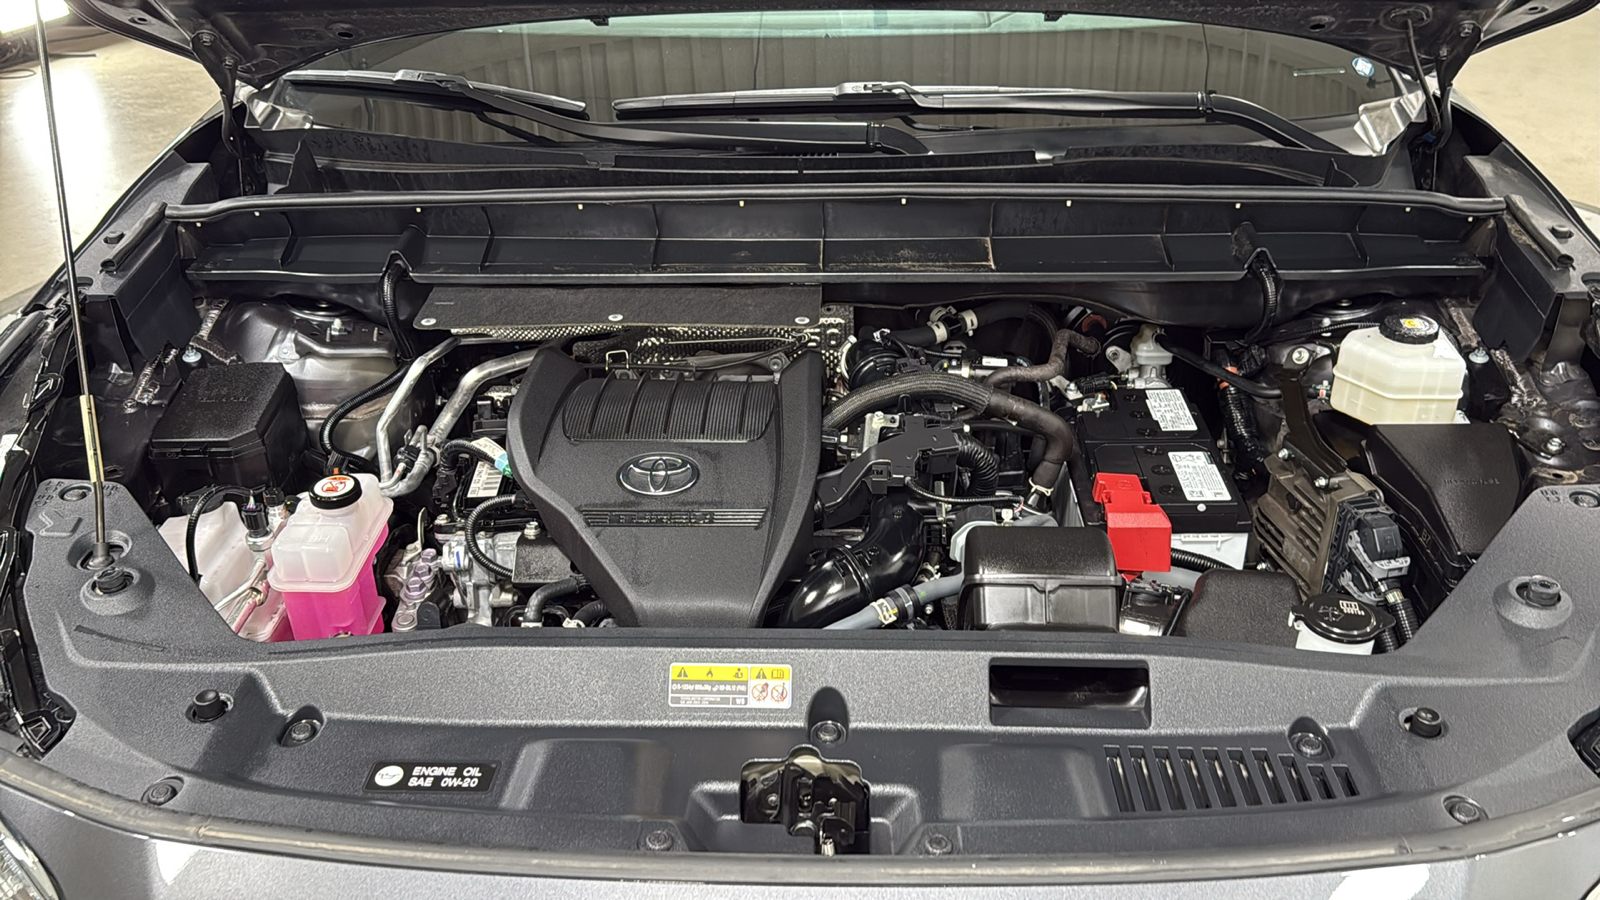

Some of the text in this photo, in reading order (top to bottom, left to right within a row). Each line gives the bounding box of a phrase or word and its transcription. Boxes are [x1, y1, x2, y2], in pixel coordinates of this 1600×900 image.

[412, 766, 482, 777] ENGINE OIL
[408, 777, 479, 787] SAE 0W-20
